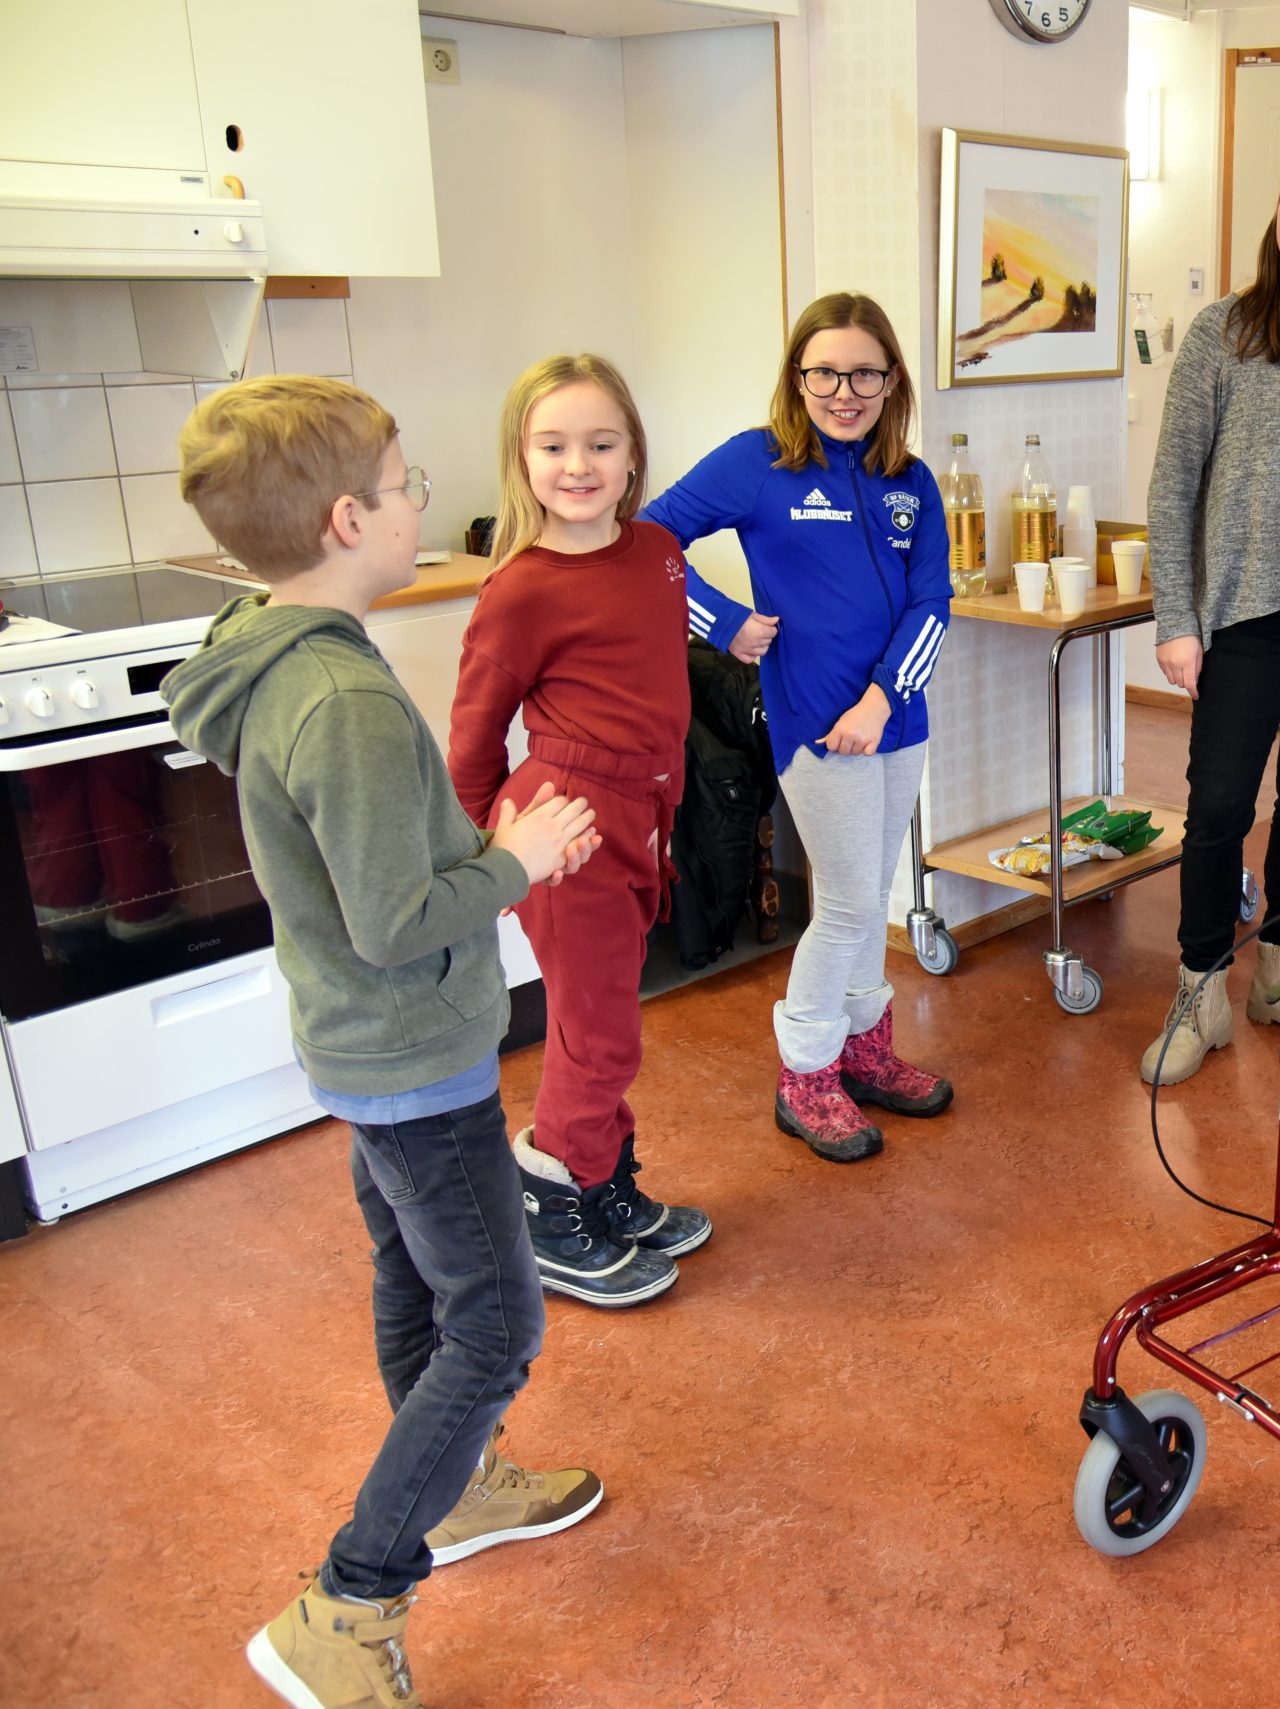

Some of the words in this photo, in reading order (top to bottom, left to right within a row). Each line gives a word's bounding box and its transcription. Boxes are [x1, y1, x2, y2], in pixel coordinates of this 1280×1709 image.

[1024, 1, 1033, 16] 7
[1059, 8, 1069, 22] 5
[1041, 12, 1051, 27] 6
[803, 499, 832, 507] adidas
